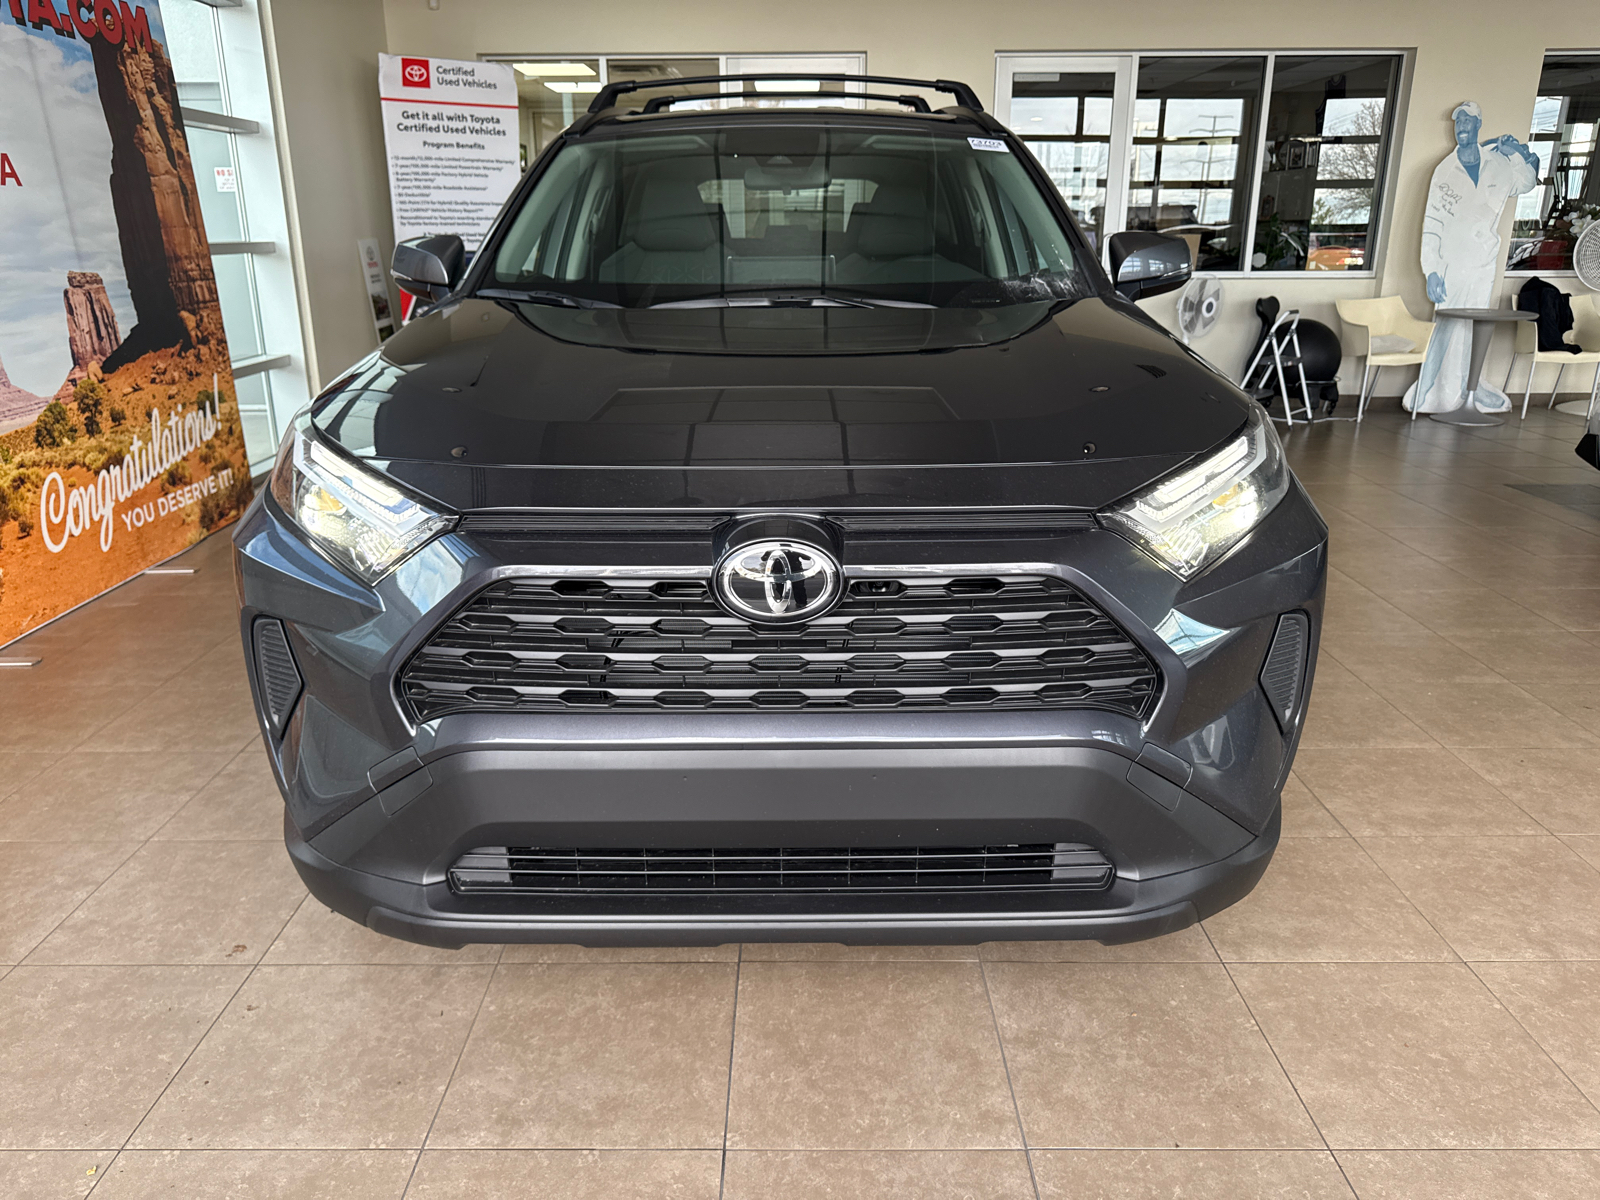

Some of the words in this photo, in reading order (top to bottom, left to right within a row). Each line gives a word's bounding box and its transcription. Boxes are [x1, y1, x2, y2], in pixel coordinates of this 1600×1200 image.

[436, 65, 475, 77] Certified
[437, 77, 460, 87] Used
[462, 79, 498, 90] Vehicles
[402, 110, 420, 121] Get
[422, 111, 430, 121] it
[432, 112, 444, 122] all
[446, 113, 468, 123] with
[470, 114, 501, 126] Toyota
[397, 122, 440, 133] Certified
[442, 125, 467, 135] Used
[469, 126, 507, 137] Vehicles
[423, 140, 455, 150] Program
[456, 141, 485, 150] Benefits
[40, 373, 222, 553] Congratulations!
[121, 502, 156, 532] YOU
[157, 475, 218, 518] DESERVE
[218, 467, 235, 490] IT!
